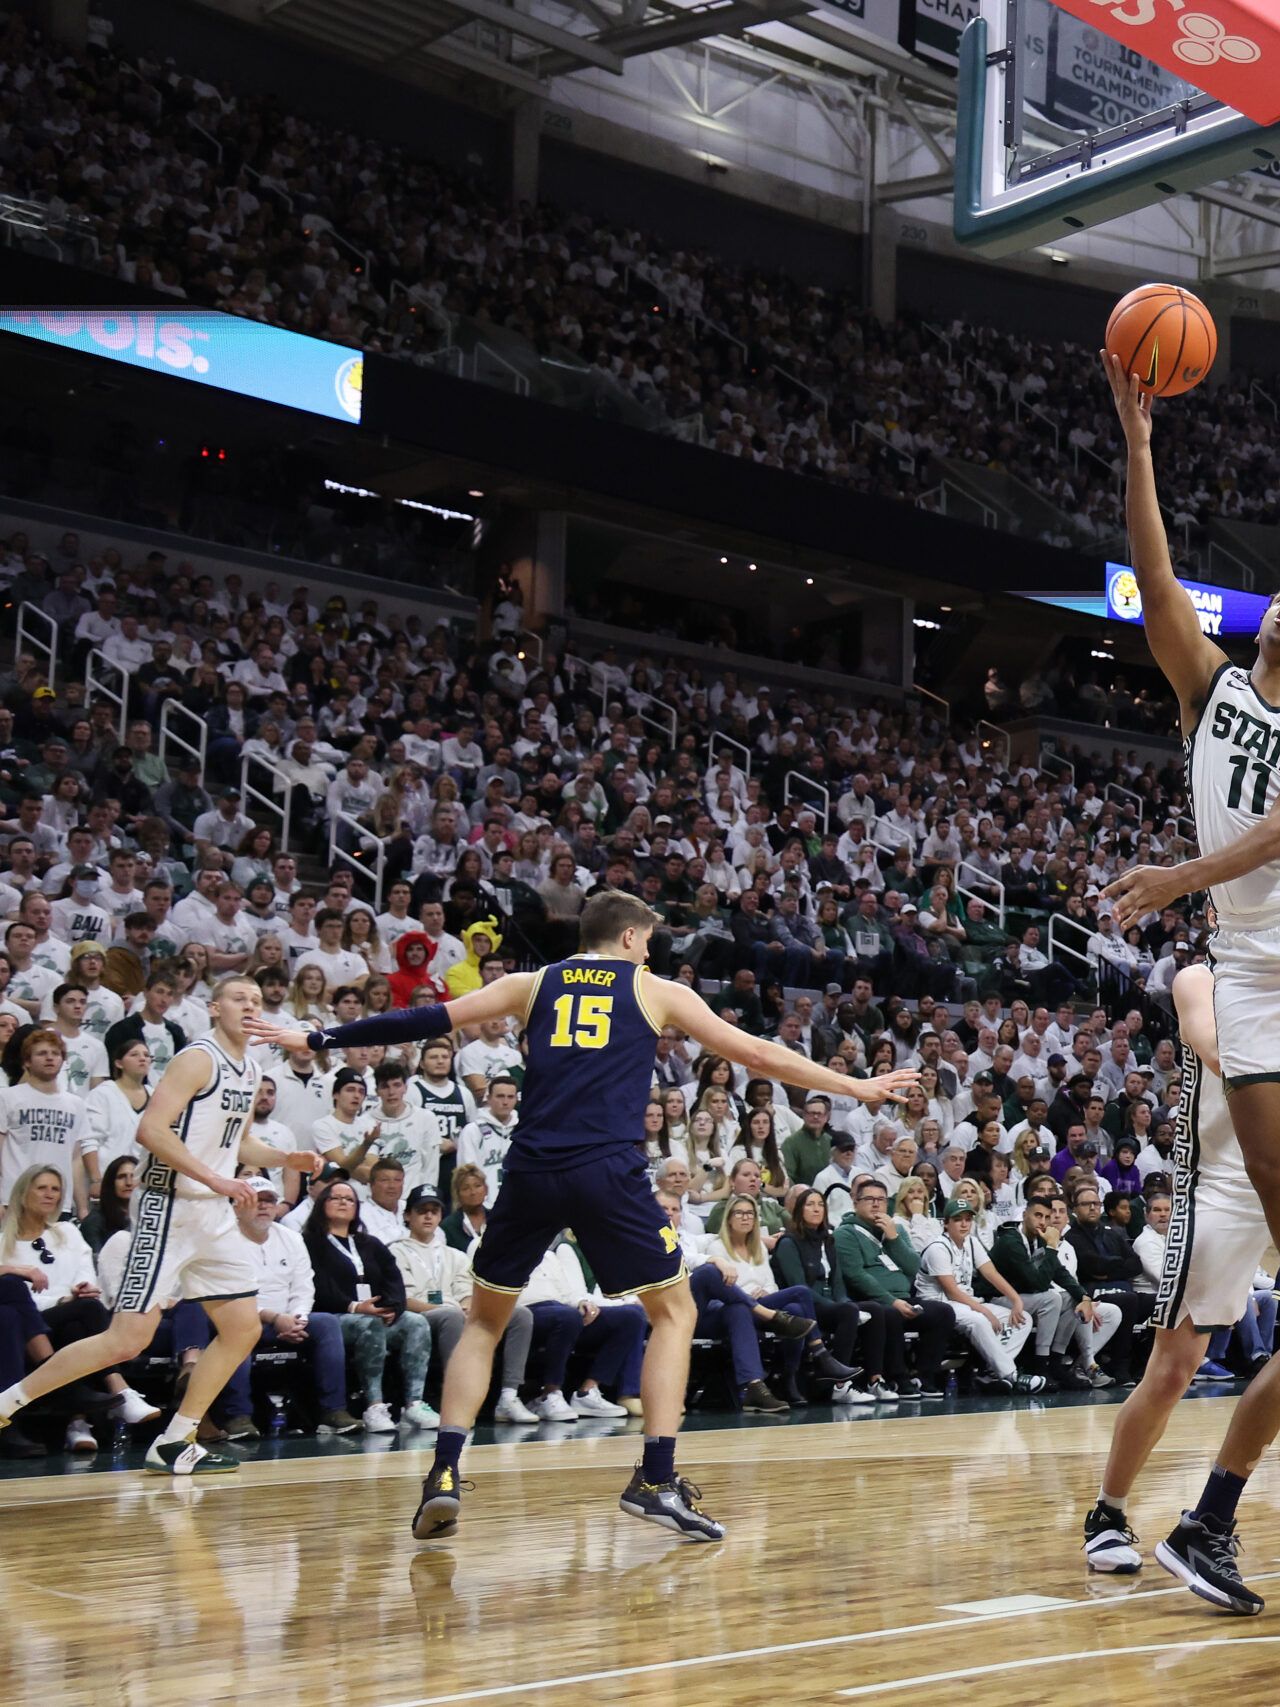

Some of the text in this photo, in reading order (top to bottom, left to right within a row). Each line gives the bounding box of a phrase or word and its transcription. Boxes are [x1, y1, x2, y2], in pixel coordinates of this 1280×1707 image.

[1227, 754, 1272, 816] 11
[562, 968, 616, 987] BAKER
[550, 993, 613, 1049] 15
[30, 1125, 66, 1144] STATE
[220, 1117, 242, 1148] 10
[957, 1199, 967, 1208] S
